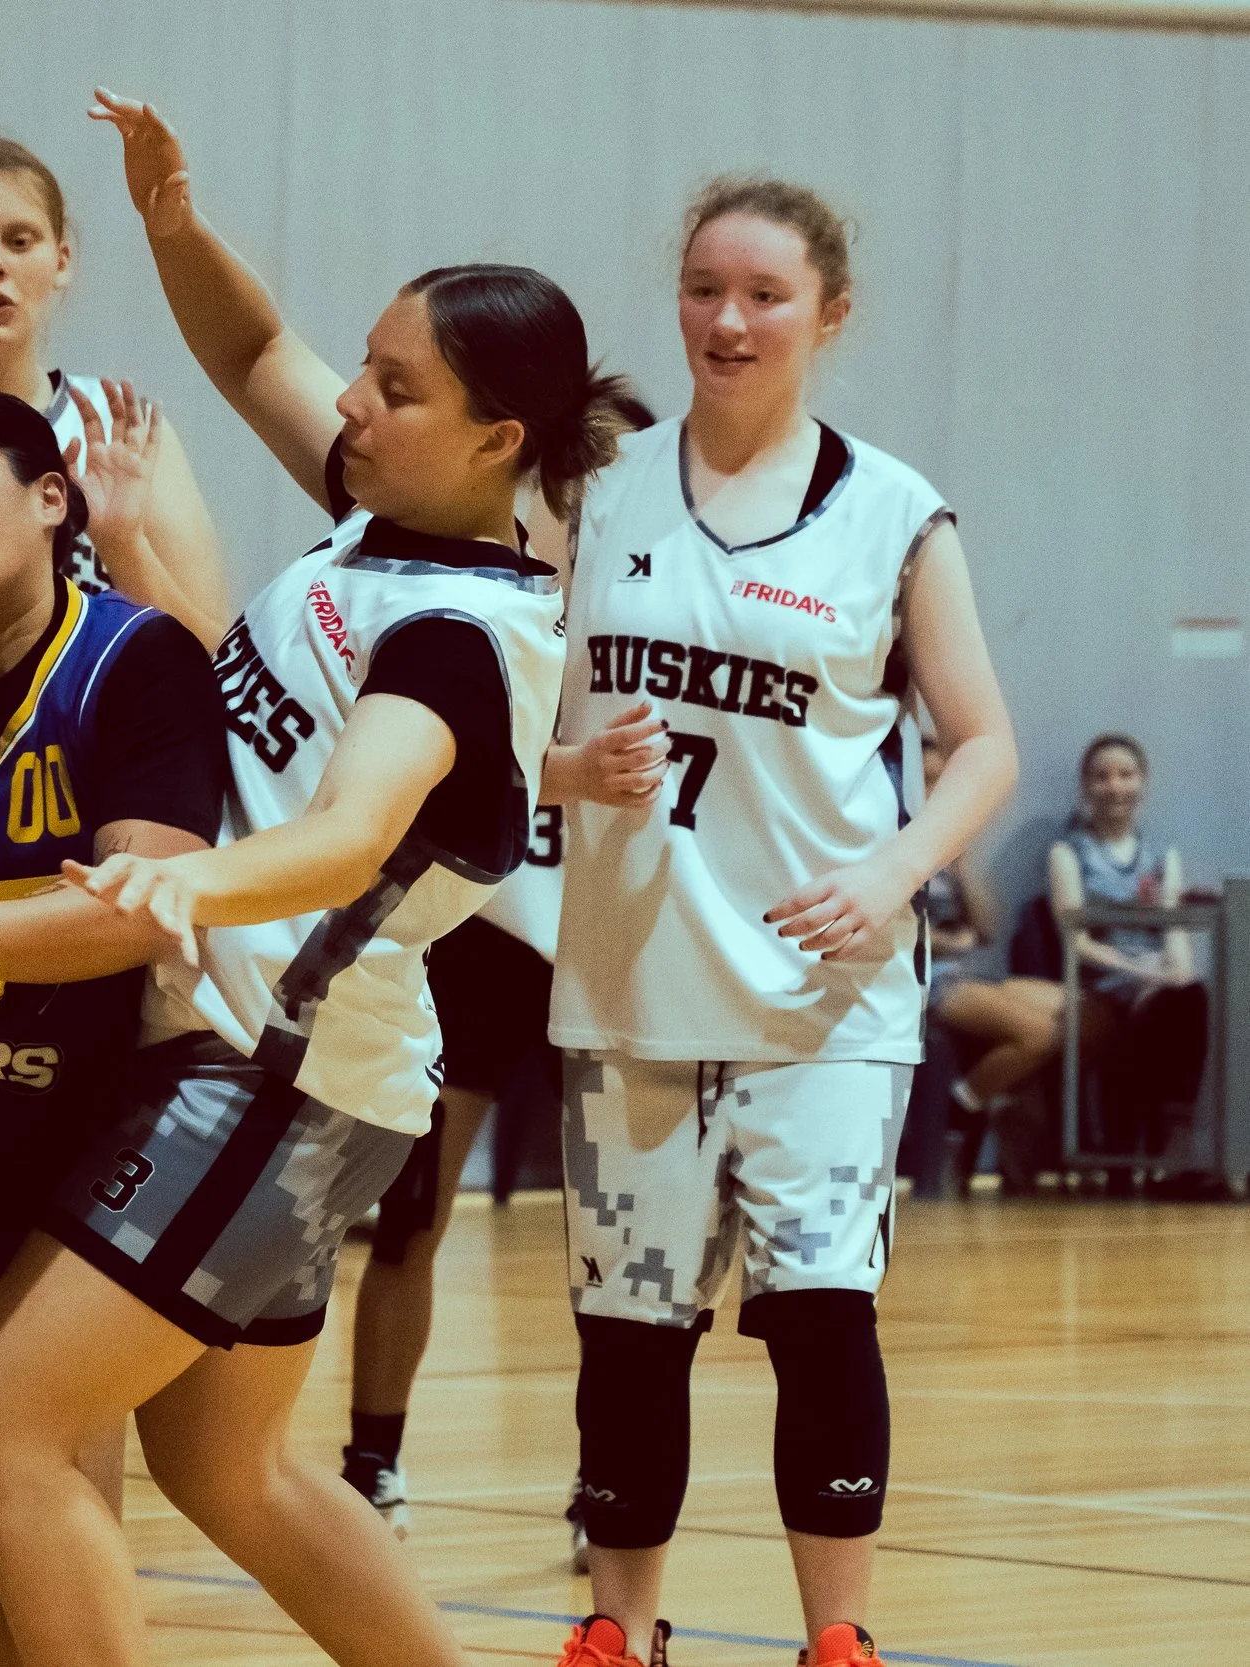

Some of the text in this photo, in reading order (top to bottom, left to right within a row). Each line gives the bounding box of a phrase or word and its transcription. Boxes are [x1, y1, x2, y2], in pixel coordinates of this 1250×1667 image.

[742, 582, 837, 622] FRIDAYS
[211, 611, 317, 774] SKIES
[588, 635, 818, 727] HUSKIES
[7, 744, 80, 844] 00
[667, 731, 717, 831] 7
[90, 1147, 155, 1213] 3
